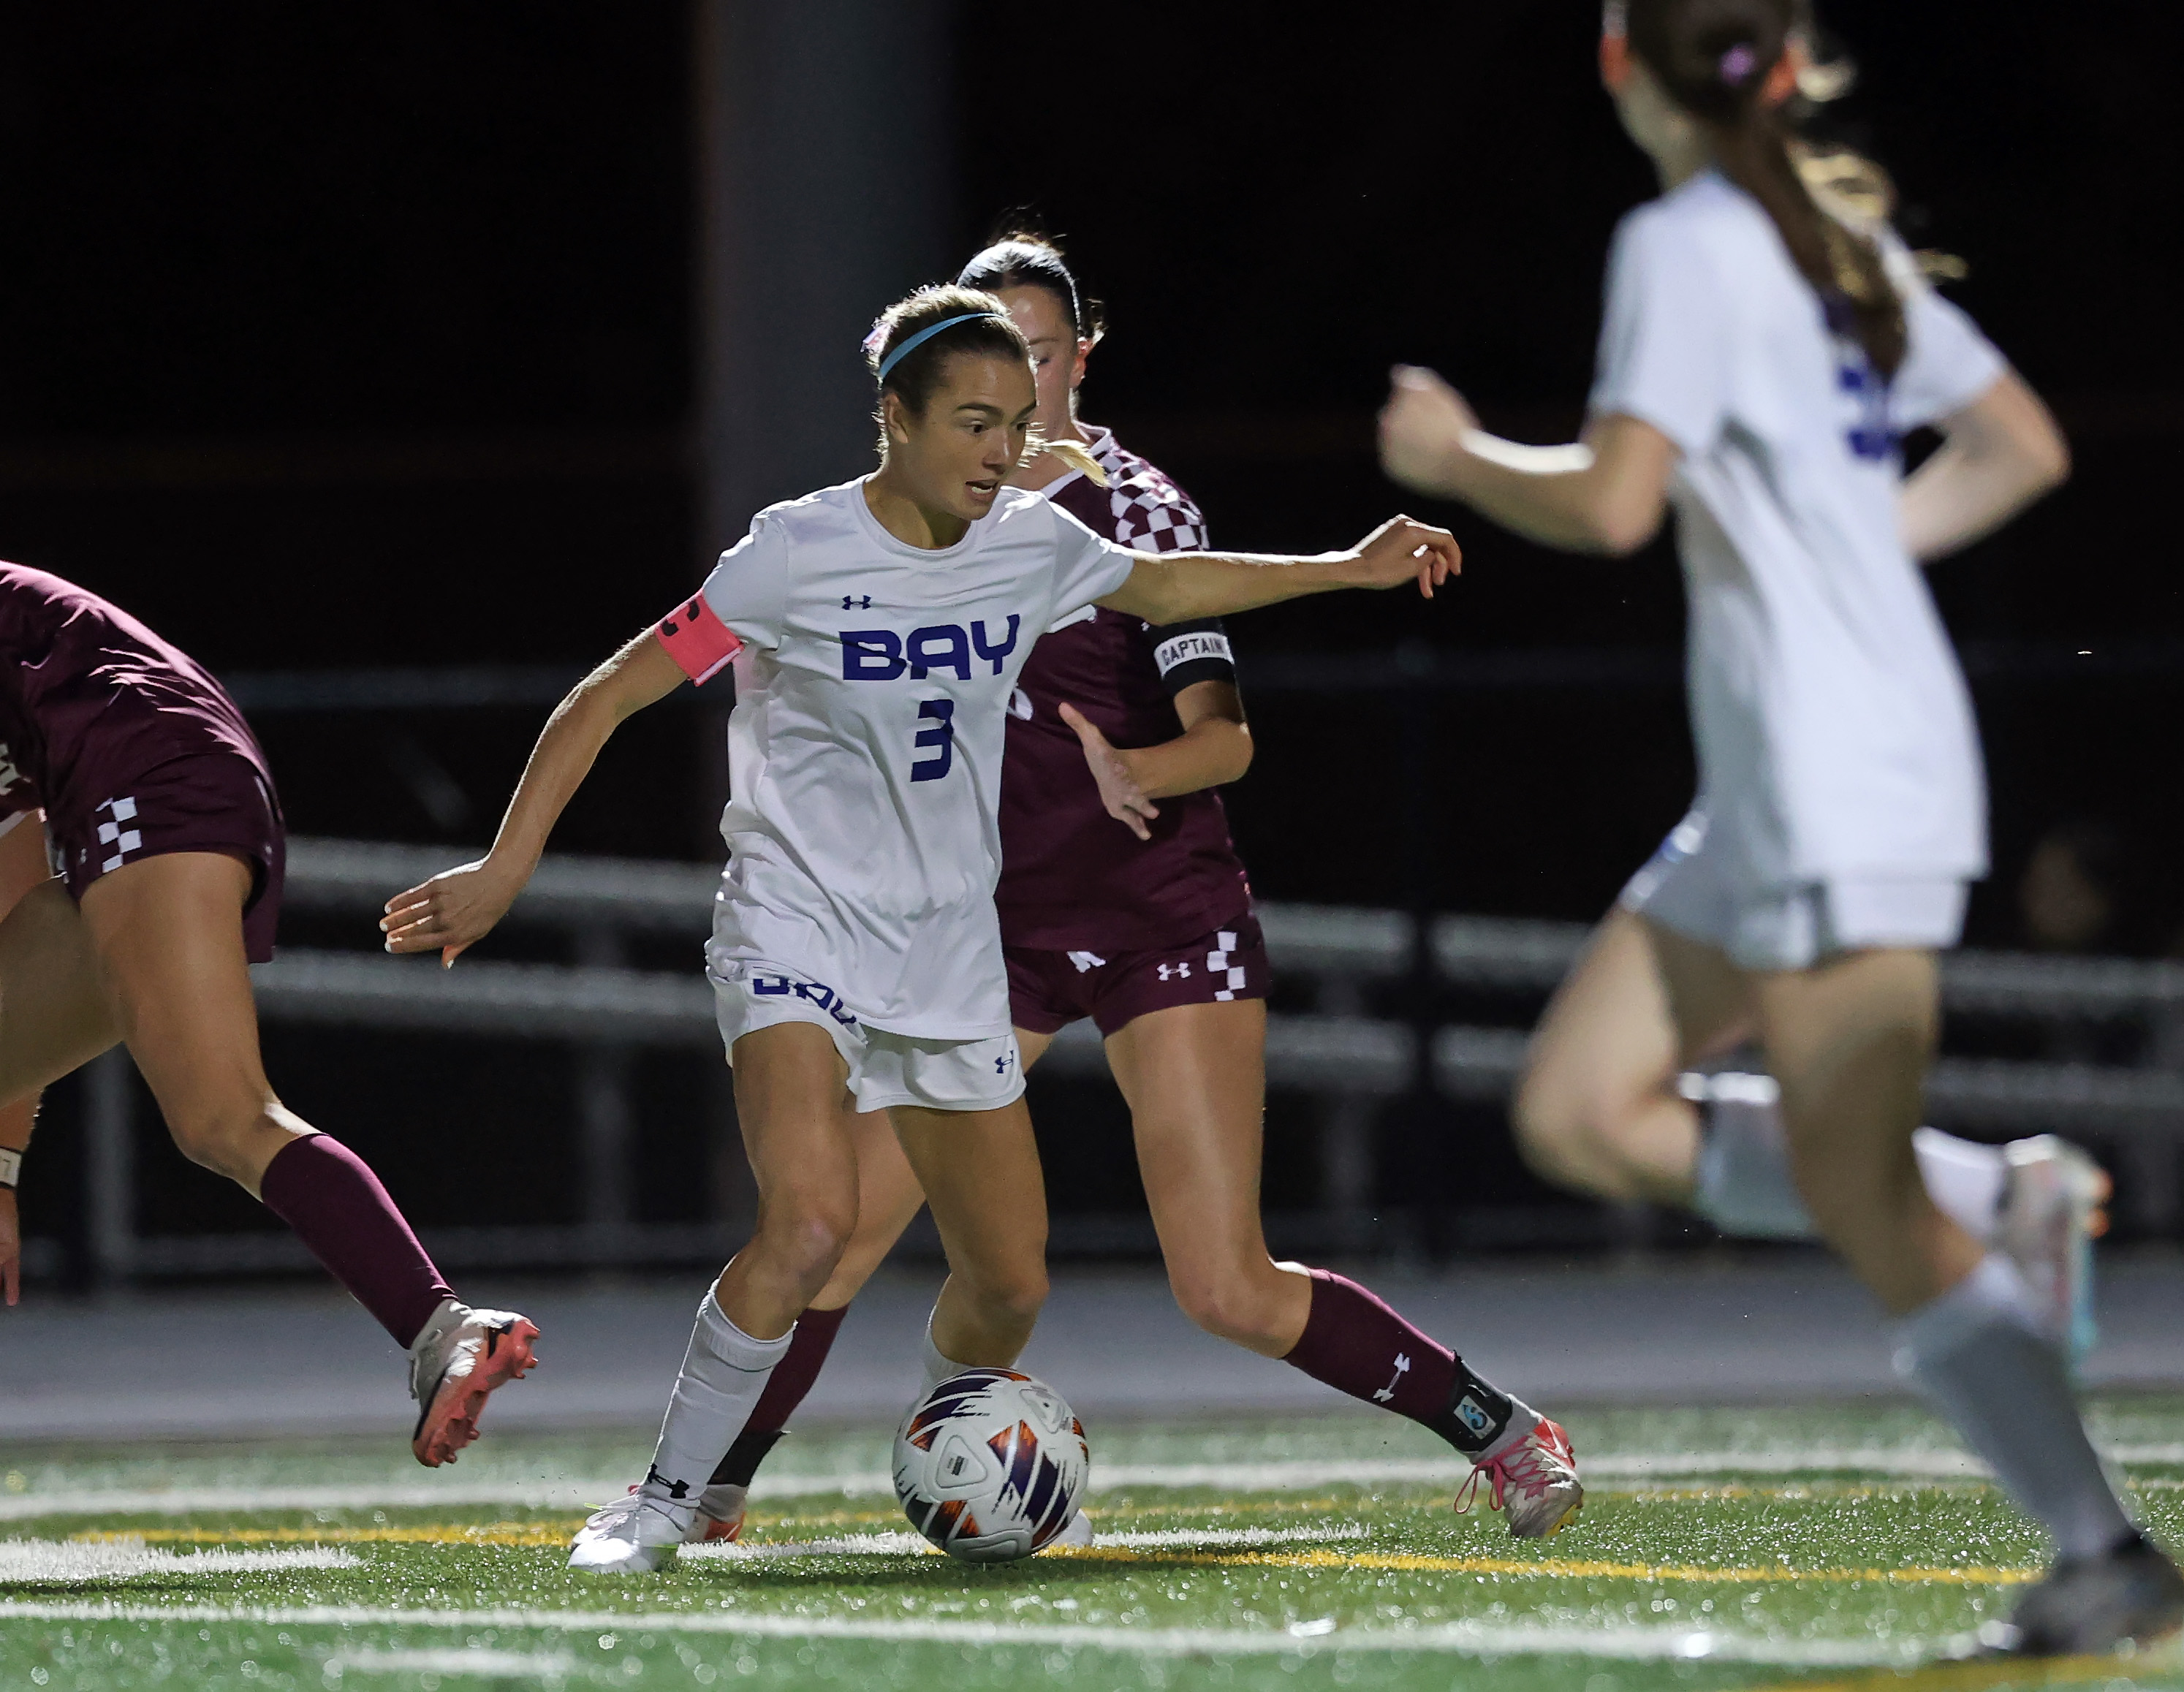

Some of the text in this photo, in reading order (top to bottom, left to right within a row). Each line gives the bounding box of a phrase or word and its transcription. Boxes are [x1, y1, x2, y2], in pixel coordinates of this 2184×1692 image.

[838, 614, 1020, 680] BAY
[1161, 637, 1225, 667] CAPTAIN
[910, 699, 954, 783] 3
